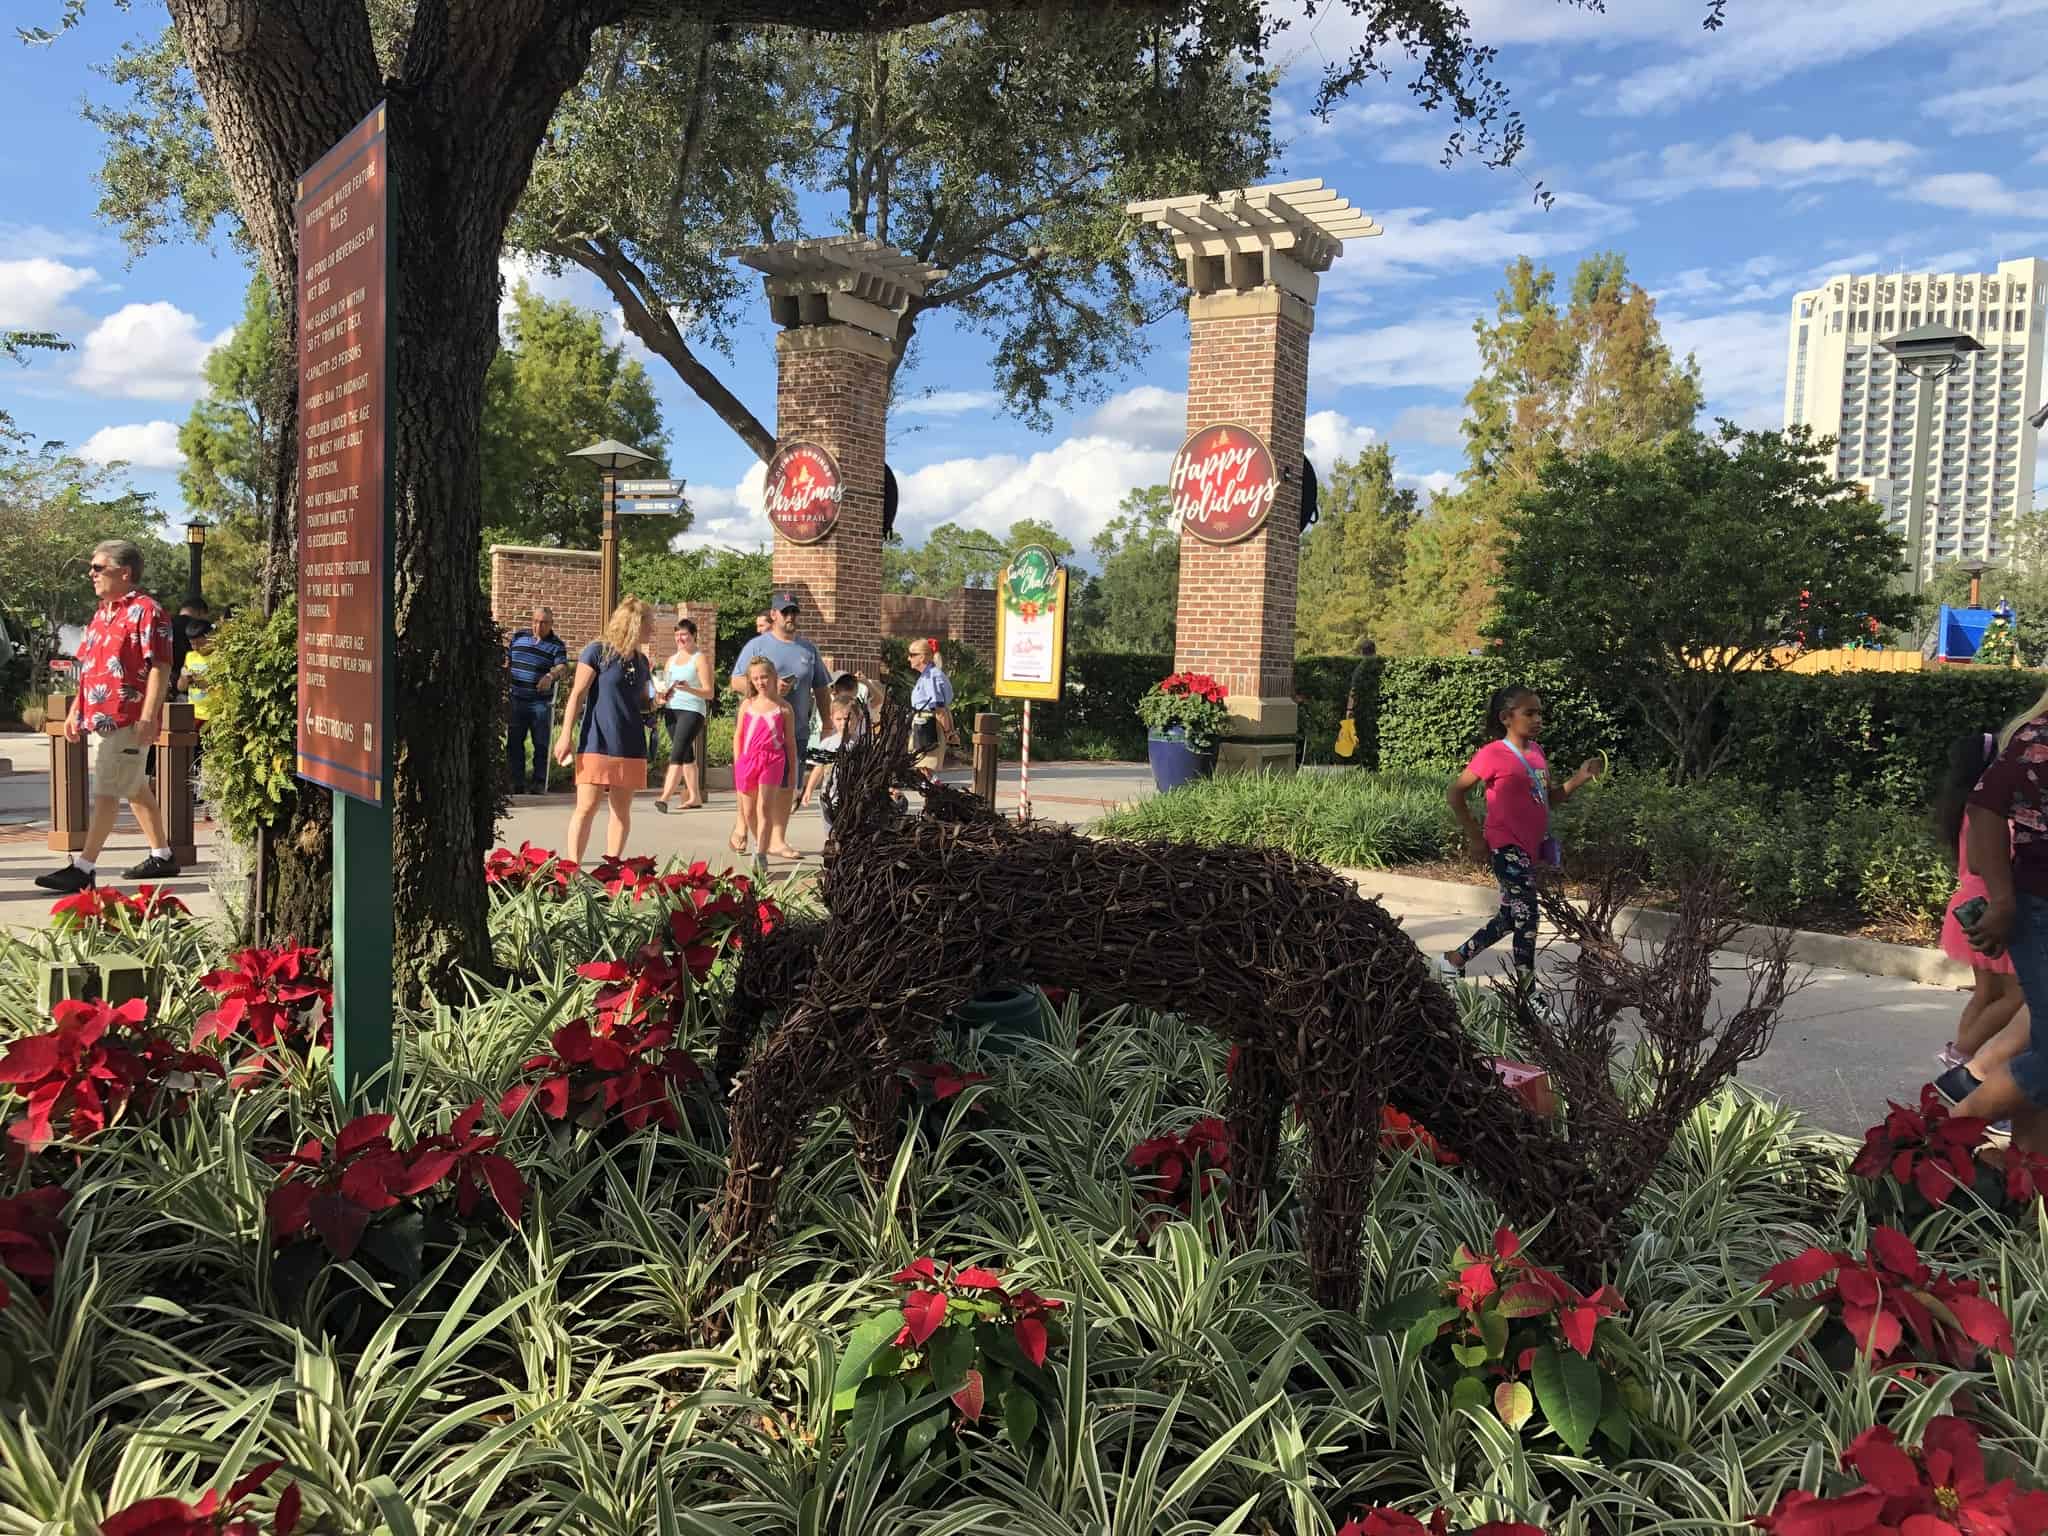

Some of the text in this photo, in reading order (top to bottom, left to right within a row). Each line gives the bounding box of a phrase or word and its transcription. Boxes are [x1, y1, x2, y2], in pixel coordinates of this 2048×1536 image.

[306, 161, 375, 227] INTERACTIVE WATER FEATURE
[330, 206, 347, 232] RULES
[315, 258, 327, 277] FOOD
[328, 252, 335, 268] OR
[336, 231, 365, 263] BEVERAGES
[366, 224, 375, 241] ON
[307, 277, 330, 302] WET DECK
[315, 308, 329, 327] GLASS
[330, 303, 337, 319] ON
[338, 299, 345, 314] OR
[347, 287, 365, 308] WITHIN
[321, 326, 335, 344] FROM
[336, 320, 346, 336] WET
[347, 312, 361, 330] DECK
[331, 356, 337, 371] 23
[338, 344, 361, 367] PERSONS
[336, 384, 342, 400] TO
[343, 373, 368, 395] MIDNIGHT
[308, 404, 370, 439] CHILDREN UNDER THE AGE
[307, 446, 313, 459] OF
[320, 440, 332, 456] MUST
[333, 436, 346, 451] HAVE
[347, 430, 363, 447] ADULT
[1171, 448, 1257, 491] Happy
[307, 485, 359, 508] DO NOT SWALLOW THE
[763, 475, 848, 513] Christmas
[1168, 478, 1280, 529] Holidays
[307, 512, 329, 528] FOUNTAIN
[348, 508, 354, 522] IT
[802, 514, 827, 522] TRAIL
[307, 536, 312, 548] IS
[307, 560, 370, 576] DO NOT USE THE FOUNTAIN
[307, 583, 353, 597] IF YOU ARE ILL WITH
[336, 634, 352, 648] DIAPER
[354, 636, 364, 650] AGE
[306, 652, 372, 673] CHILDREN MUST WEAR SWIM
[315, 715, 354, 742] RESTROOMS
